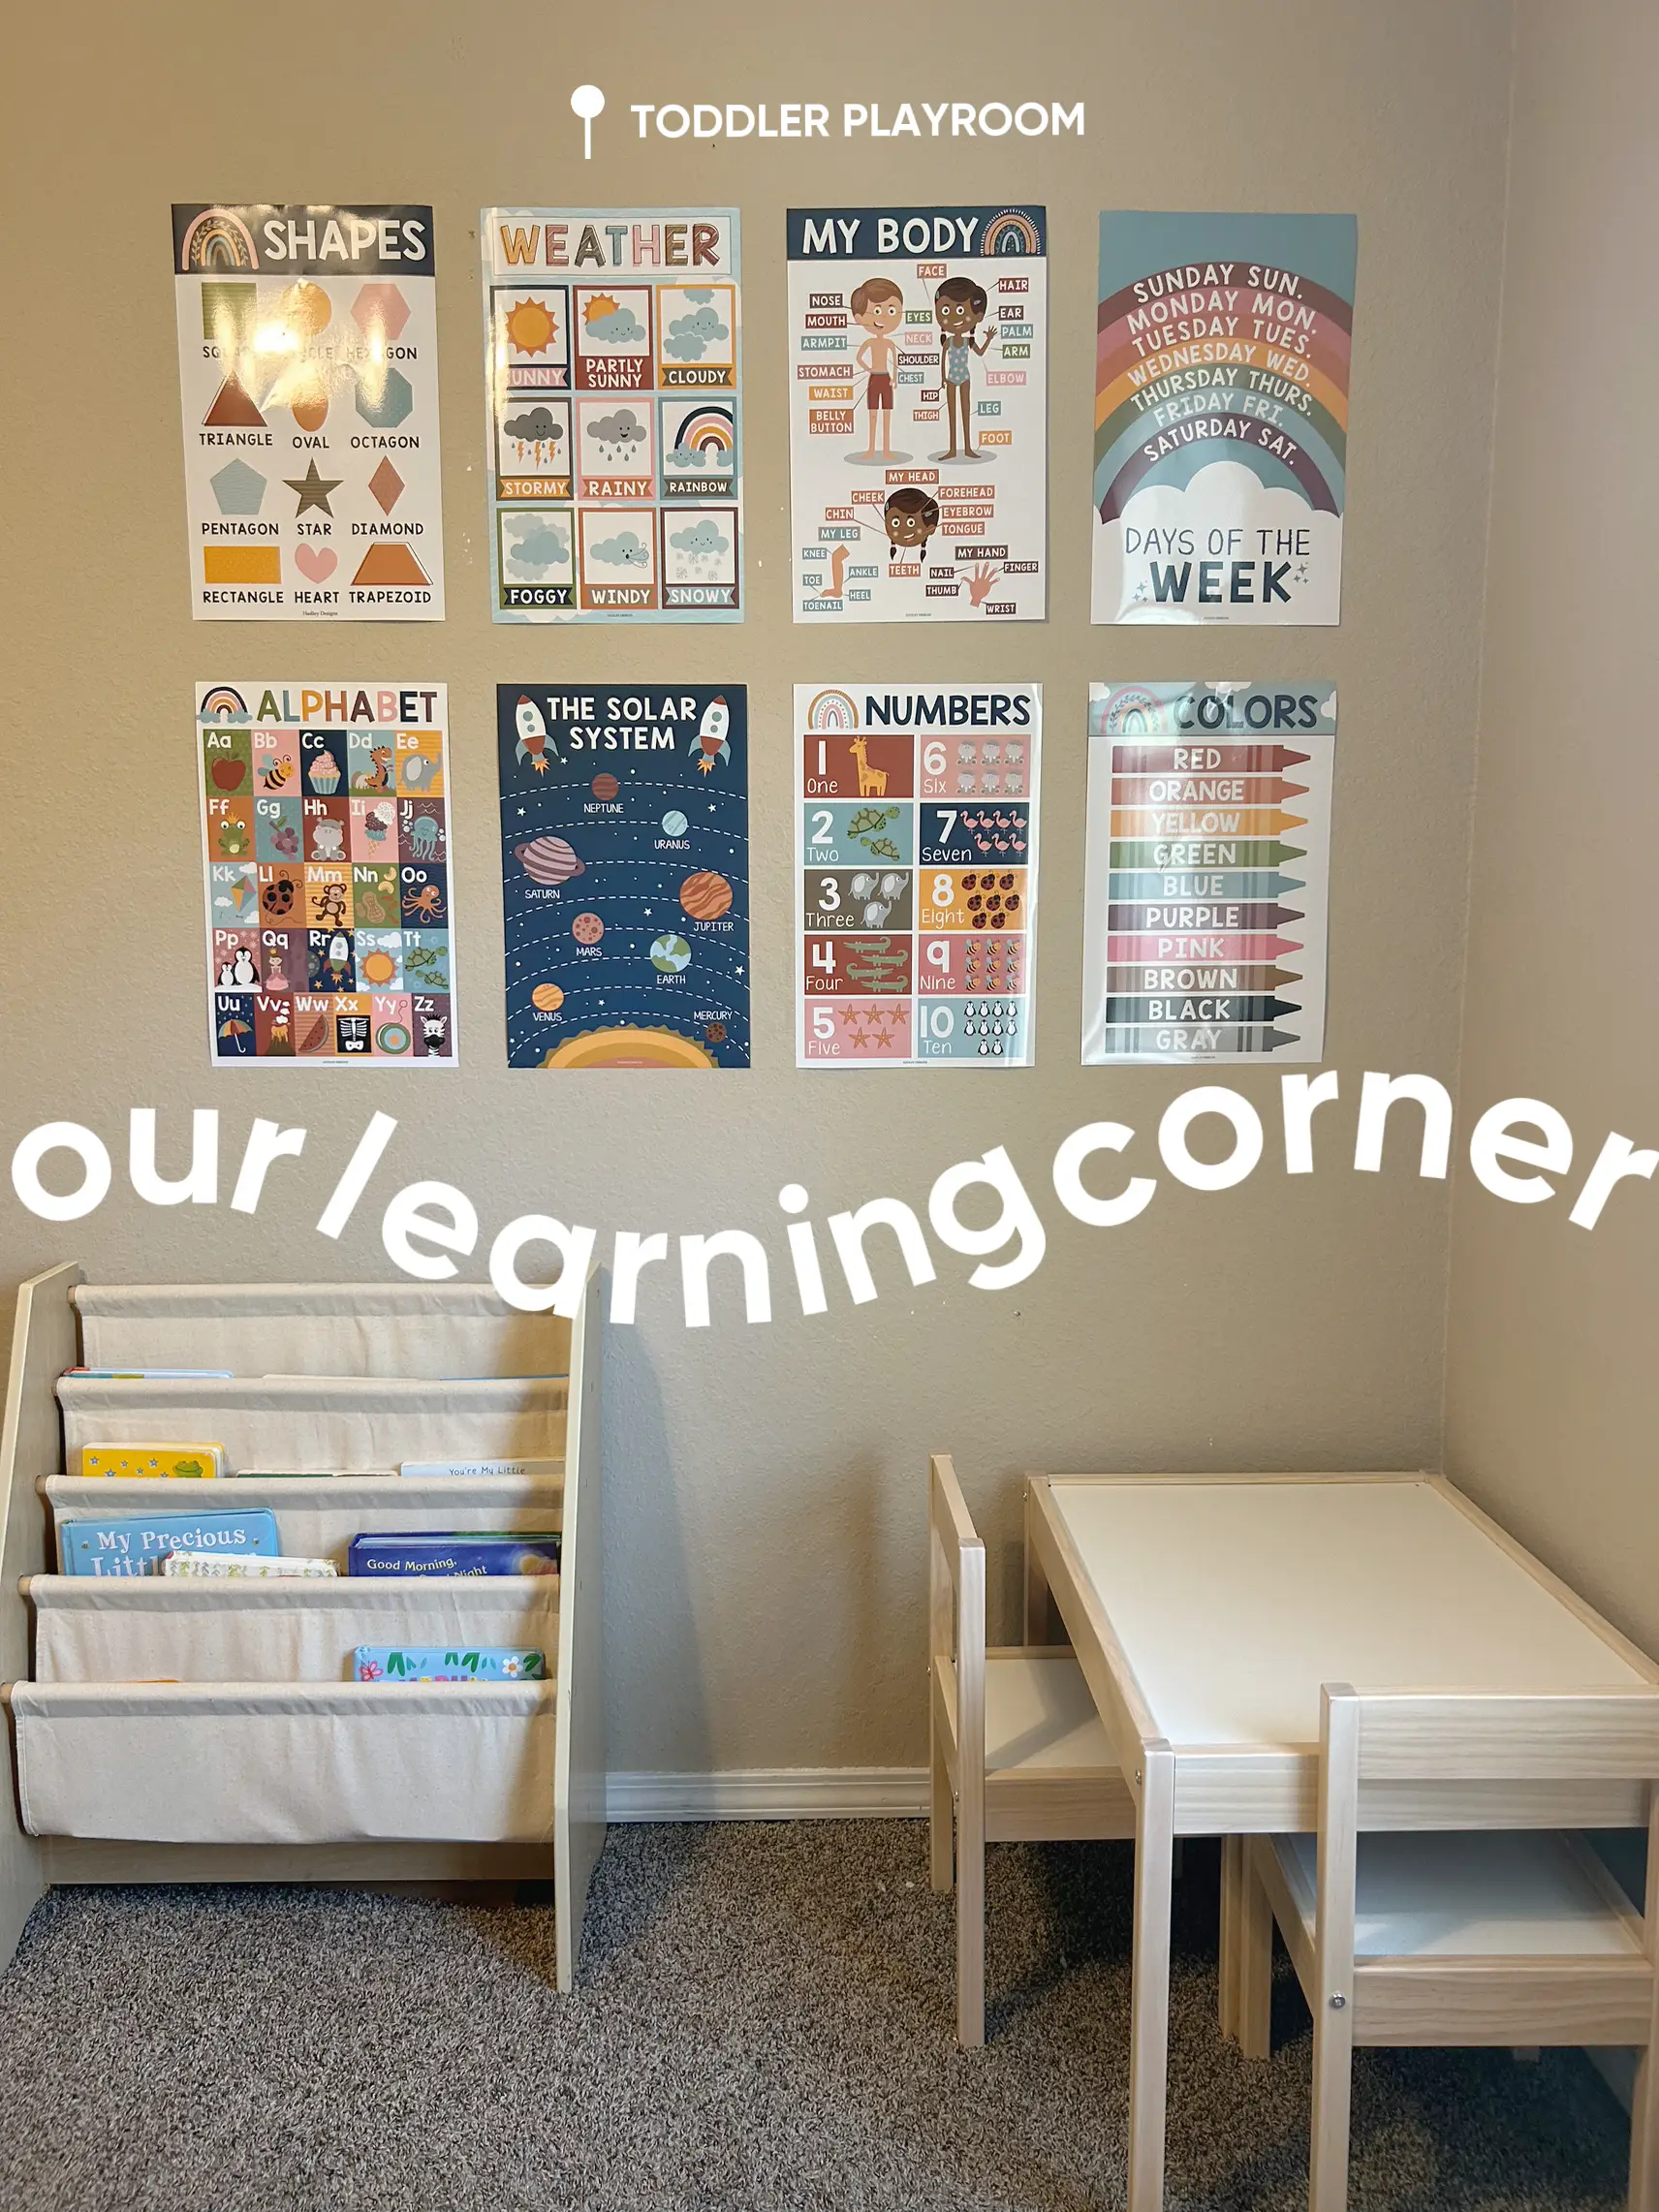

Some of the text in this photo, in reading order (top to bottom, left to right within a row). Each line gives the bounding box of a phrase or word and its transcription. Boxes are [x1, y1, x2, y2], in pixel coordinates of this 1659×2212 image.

[264, 220, 426, 261] SHAPES
[802, 217, 978, 254] MY BODY
[500, 223, 721, 267] WEATHER
[919, 265, 945, 277] FACE
[999, 279, 1027, 292] HAIR
[1133, 264, 1303, 303] SUNDAY SUN.
[812, 296, 841, 306] NOSE
[907, 312, 931, 323] EYES
[1000, 307, 1021, 318] EAR
[1127, 290, 1317, 335] MONDAY MON.
[807, 316, 846, 327] MOUTH
[906, 333, 932, 344] NECK
[1002, 326, 1032, 337] PALM
[1131, 316, 1311, 359] TUESDAY TUES.
[802, 337, 846, 349] ARMPIT
[1003, 346, 1028, 358] ARM
[586, 358, 643, 373] PARTLY
[898, 355, 939, 364] SHOULDER
[1127, 342, 1310, 388] WEDNESDAY WED.
[510, 369, 562, 386] UNNY
[669, 370, 727, 384] CLOUDY
[798, 366, 850, 378] STOMACH
[898, 373, 923, 383] CHEST
[987, 372, 1025, 385] ELBOW
[588, 374, 642, 388] SUNNY
[813, 388, 848, 399] WAIST
[923, 391, 938, 400] HIP
[1130, 367, 1313, 417] THURSDAY THURS.
[980, 403, 1000, 414] LEG
[1153, 392, 1284, 428] FRIDAY FRI.
[816, 411, 846, 421] BELLY
[914, 411, 939, 421] THIGH
[810, 422, 853, 433] BUTTON
[199, 433, 273, 446] TRIANGLE
[292, 436, 329, 449] OVAL
[350, 436, 420, 449] OCTAGON
[981, 433, 1010, 444] FOOT
[1143, 418, 1298, 465] SATURDAY SAT.
[889, 472, 935, 482] MY HEAD
[505, 482, 566, 495] STORMY
[588, 481, 647, 496] RAINY
[670, 482, 728, 493] RAINBOW
[939, 486, 993, 498] FOREHEAD
[852, 492, 884, 503] CHEEK
[826, 509, 854, 519] CHIN
[943, 506, 992, 517] EYEBROW
[202, 522, 279, 535] PENTAGON
[297, 523, 332, 536] STAR
[352, 522, 424, 535] DIAMOND
[821, 529, 859, 539] MY LEG
[943, 523, 984, 534] TONGUE
[1125, 528, 1310, 556] DAYS OF THE
[803, 548, 827, 558] KNEE
[957, 547, 1006, 558] MY HAND
[850, 567, 878, 576] ANKLE
[890, 565, 920, 576] TEETH
[930, 568, 954, 577] NAIL
[1004, 562, 1038, 572] FINGER
[804, 576, 821, 584] TOE
[1149, 561, 1292, 603] WEEK
[511, 589, 567, 605] FOGGY
[591, 589, 651, 604] WINDY
[671, 588, 731, 604] SNOWY
[850, 591, 870, 600] HEEL
[926, 585, 957, 595] THUMB
[203, 591, 284, 604] RECTANGLE
[295, 591, 339, 604] HEART
[349, 591, 431, 604] TRAPEZOID
[803, 601, 842, 610] TOENAIL
[986, 604, 1016, 613] WRIST
[256, 690, 437, 723] ALPHABET
[547, 697, 697, 721] THE SOLAR
[865, 695, 1031, 727] NUMBERS
[1174, 695, 1318, 729] COLORS
[206, 733, 232, 748] Aa
[254, 733, 278, 749] Bb
[349, 733, 373, 749] Dd
[396, 733, 420, 749] Ee
[569, 727, 674, 750] SYSTEM
[923, 741, 946, 775] 6
[1174, 749, 1221, 770] RED
[807, 779, 838, 794] One
[923, 779, 947, 794] Six
[1148, 780, 1244, 801] ORANGE
[208, 798, 230, 815] Ff
[256, 799, 281, 819] Gg
[304, 800, 328, 815] Hh
[583, 803, 624, 814] NEPTUNE
[811, 810, 833, 844] 2
[936, 810, 957, 844] 7
[1152, 813, 1240, 833] YELLOW
[654, 839, 690, 850] URANUS
[807, 847, 839, 861] Two
[922, 847, 971, 861] Seven
[1153, 844, 1236, 864] GREEN
[307, 867, 342, 882] Mm
[354, 868, 378, 883] Nn
[524, 888, 560, 899] SATURN
[932, 874, 954, 907] 8
[1163, 876, 1223, 897] BLUE
[818, 877, 841, 911] 3
[806, 913, 855, 927] Three
[922, 909, 965, 929] Eight
[1146, 907, 1239, 928] PURPLE
[693, 921, 734, 932] JUPITER
[262, 930, 289, 950] Qq
[309, 931, 330, 947] Rr
[403, 931, 422, 946] Tt
[576, 947, 602, 957] MARS
[1158, 938, 1225, 958] PINK
[812, 941, 836, 974] 4
[926, 940, 950, 973] 9
[657, 975, 686, 984] EARTH
[806, 976, 843, 990] Four
[921, 976, 955, 990] Nine
[1143, 969, 1237, 989] BROWN
[694, 1011, 733, 1020] MERCURY
[1148, 999, 1230, 1020] BLACK
[533, 1012, 562, 1022] VENUS
[813, 1007, 834, 1040] 5
[921, 1006, 954, 1039] 10
[923, 1040, 952, 1054] Ten
[1156, 1030, 1222, 1050] GRAY
[808, 1040, 840, 1055] Five
[450, 1466, 526, 1476] You're My Little
[97, 1528, 246, 1554] My Precious
[367, 1557, 457, 1571] Good Morning,
